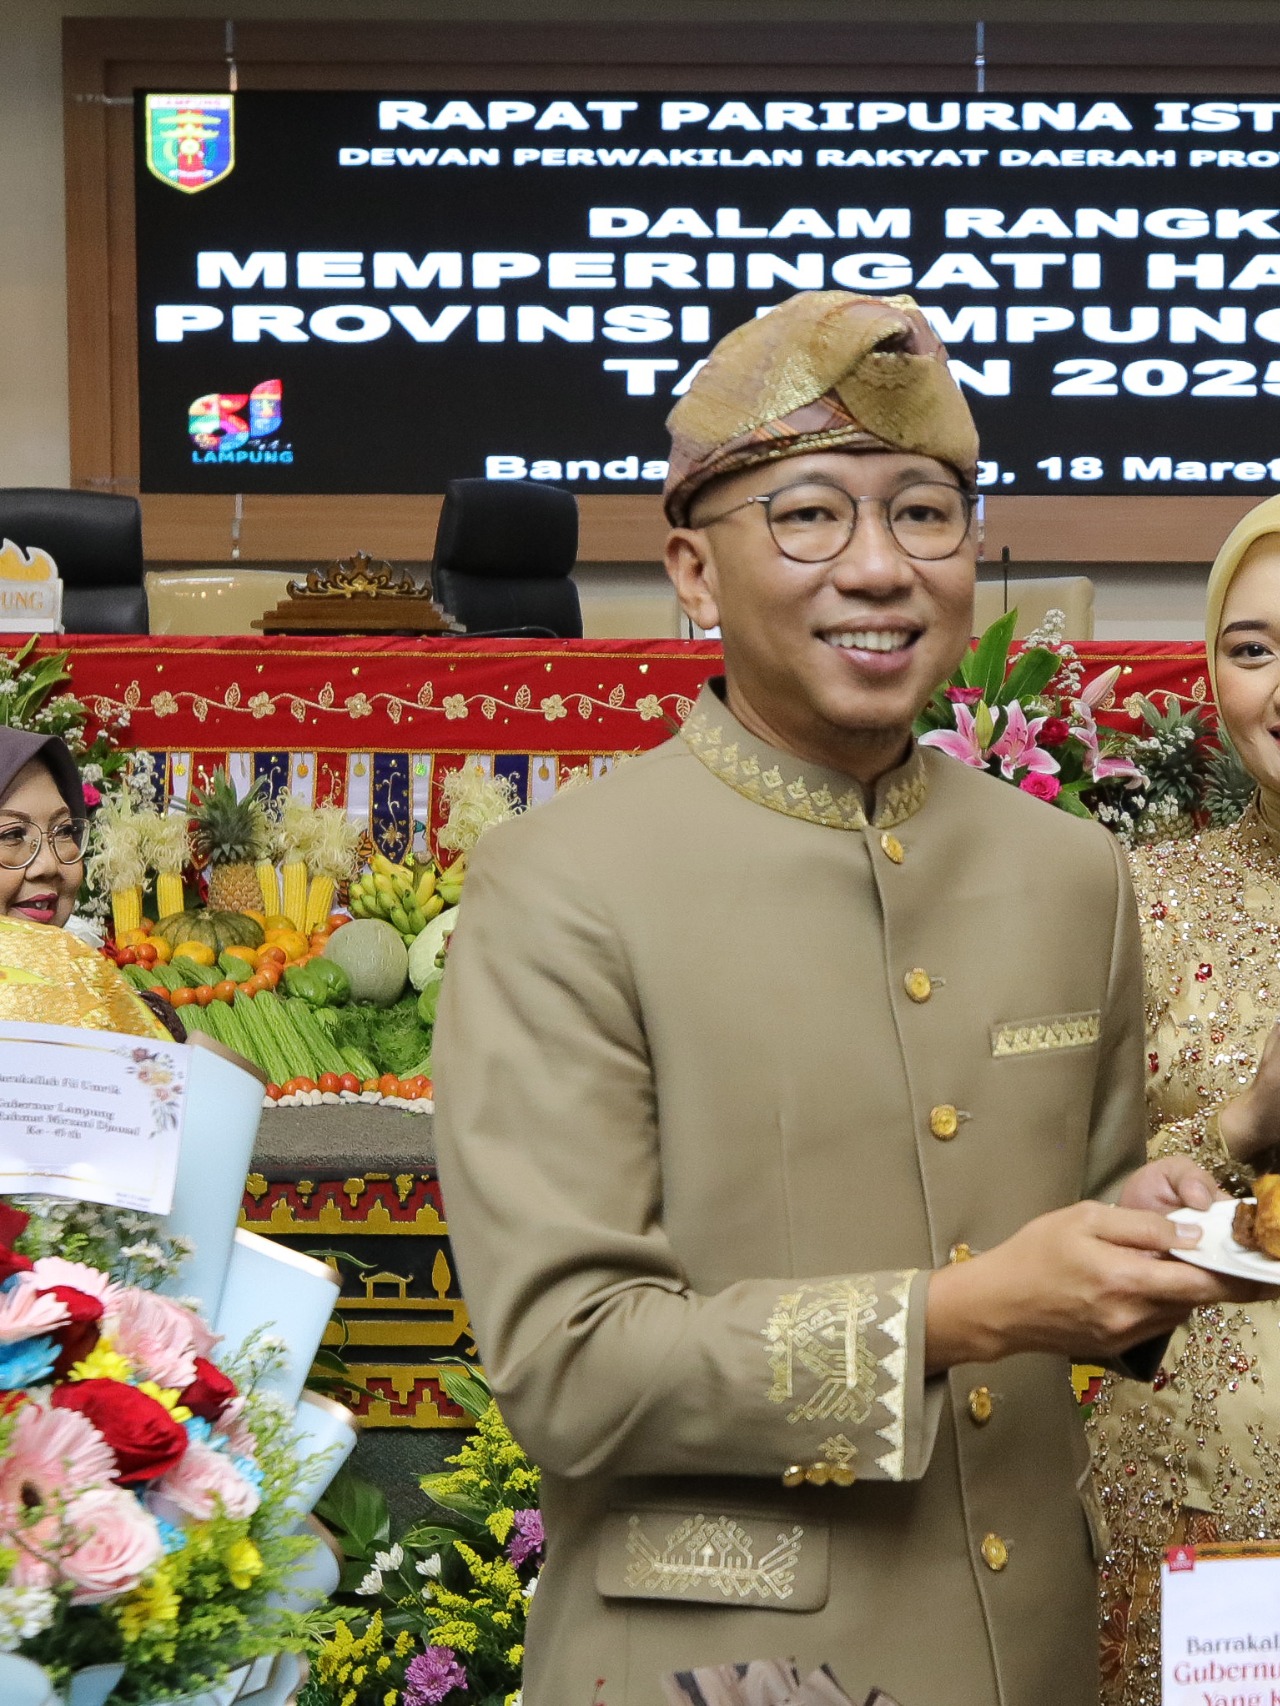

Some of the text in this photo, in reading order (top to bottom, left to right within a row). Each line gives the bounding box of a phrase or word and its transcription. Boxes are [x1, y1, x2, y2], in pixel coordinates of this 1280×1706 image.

[379, 101, 638, 131] RAPAT
[661, 102, 1132, 131] PARIPURNA
[339, 148, 500, 167] DEWAN
[514, 148, 802, 167] PERWAKILAN
[817, 149, 989, 167] RAKYAT
[1000, 149, 1176, 168] DAERAH
[589, 208, 911, 238] DALAM
[197, 252, 1101, 290] MEMPERINGATI
[156, 305, 710, 342] PROVINSI
[191, 451, 294, 463] LAMPUNG
[486, 456, 669, 480] Banda
[1037, 457, 1103, 480] 18
